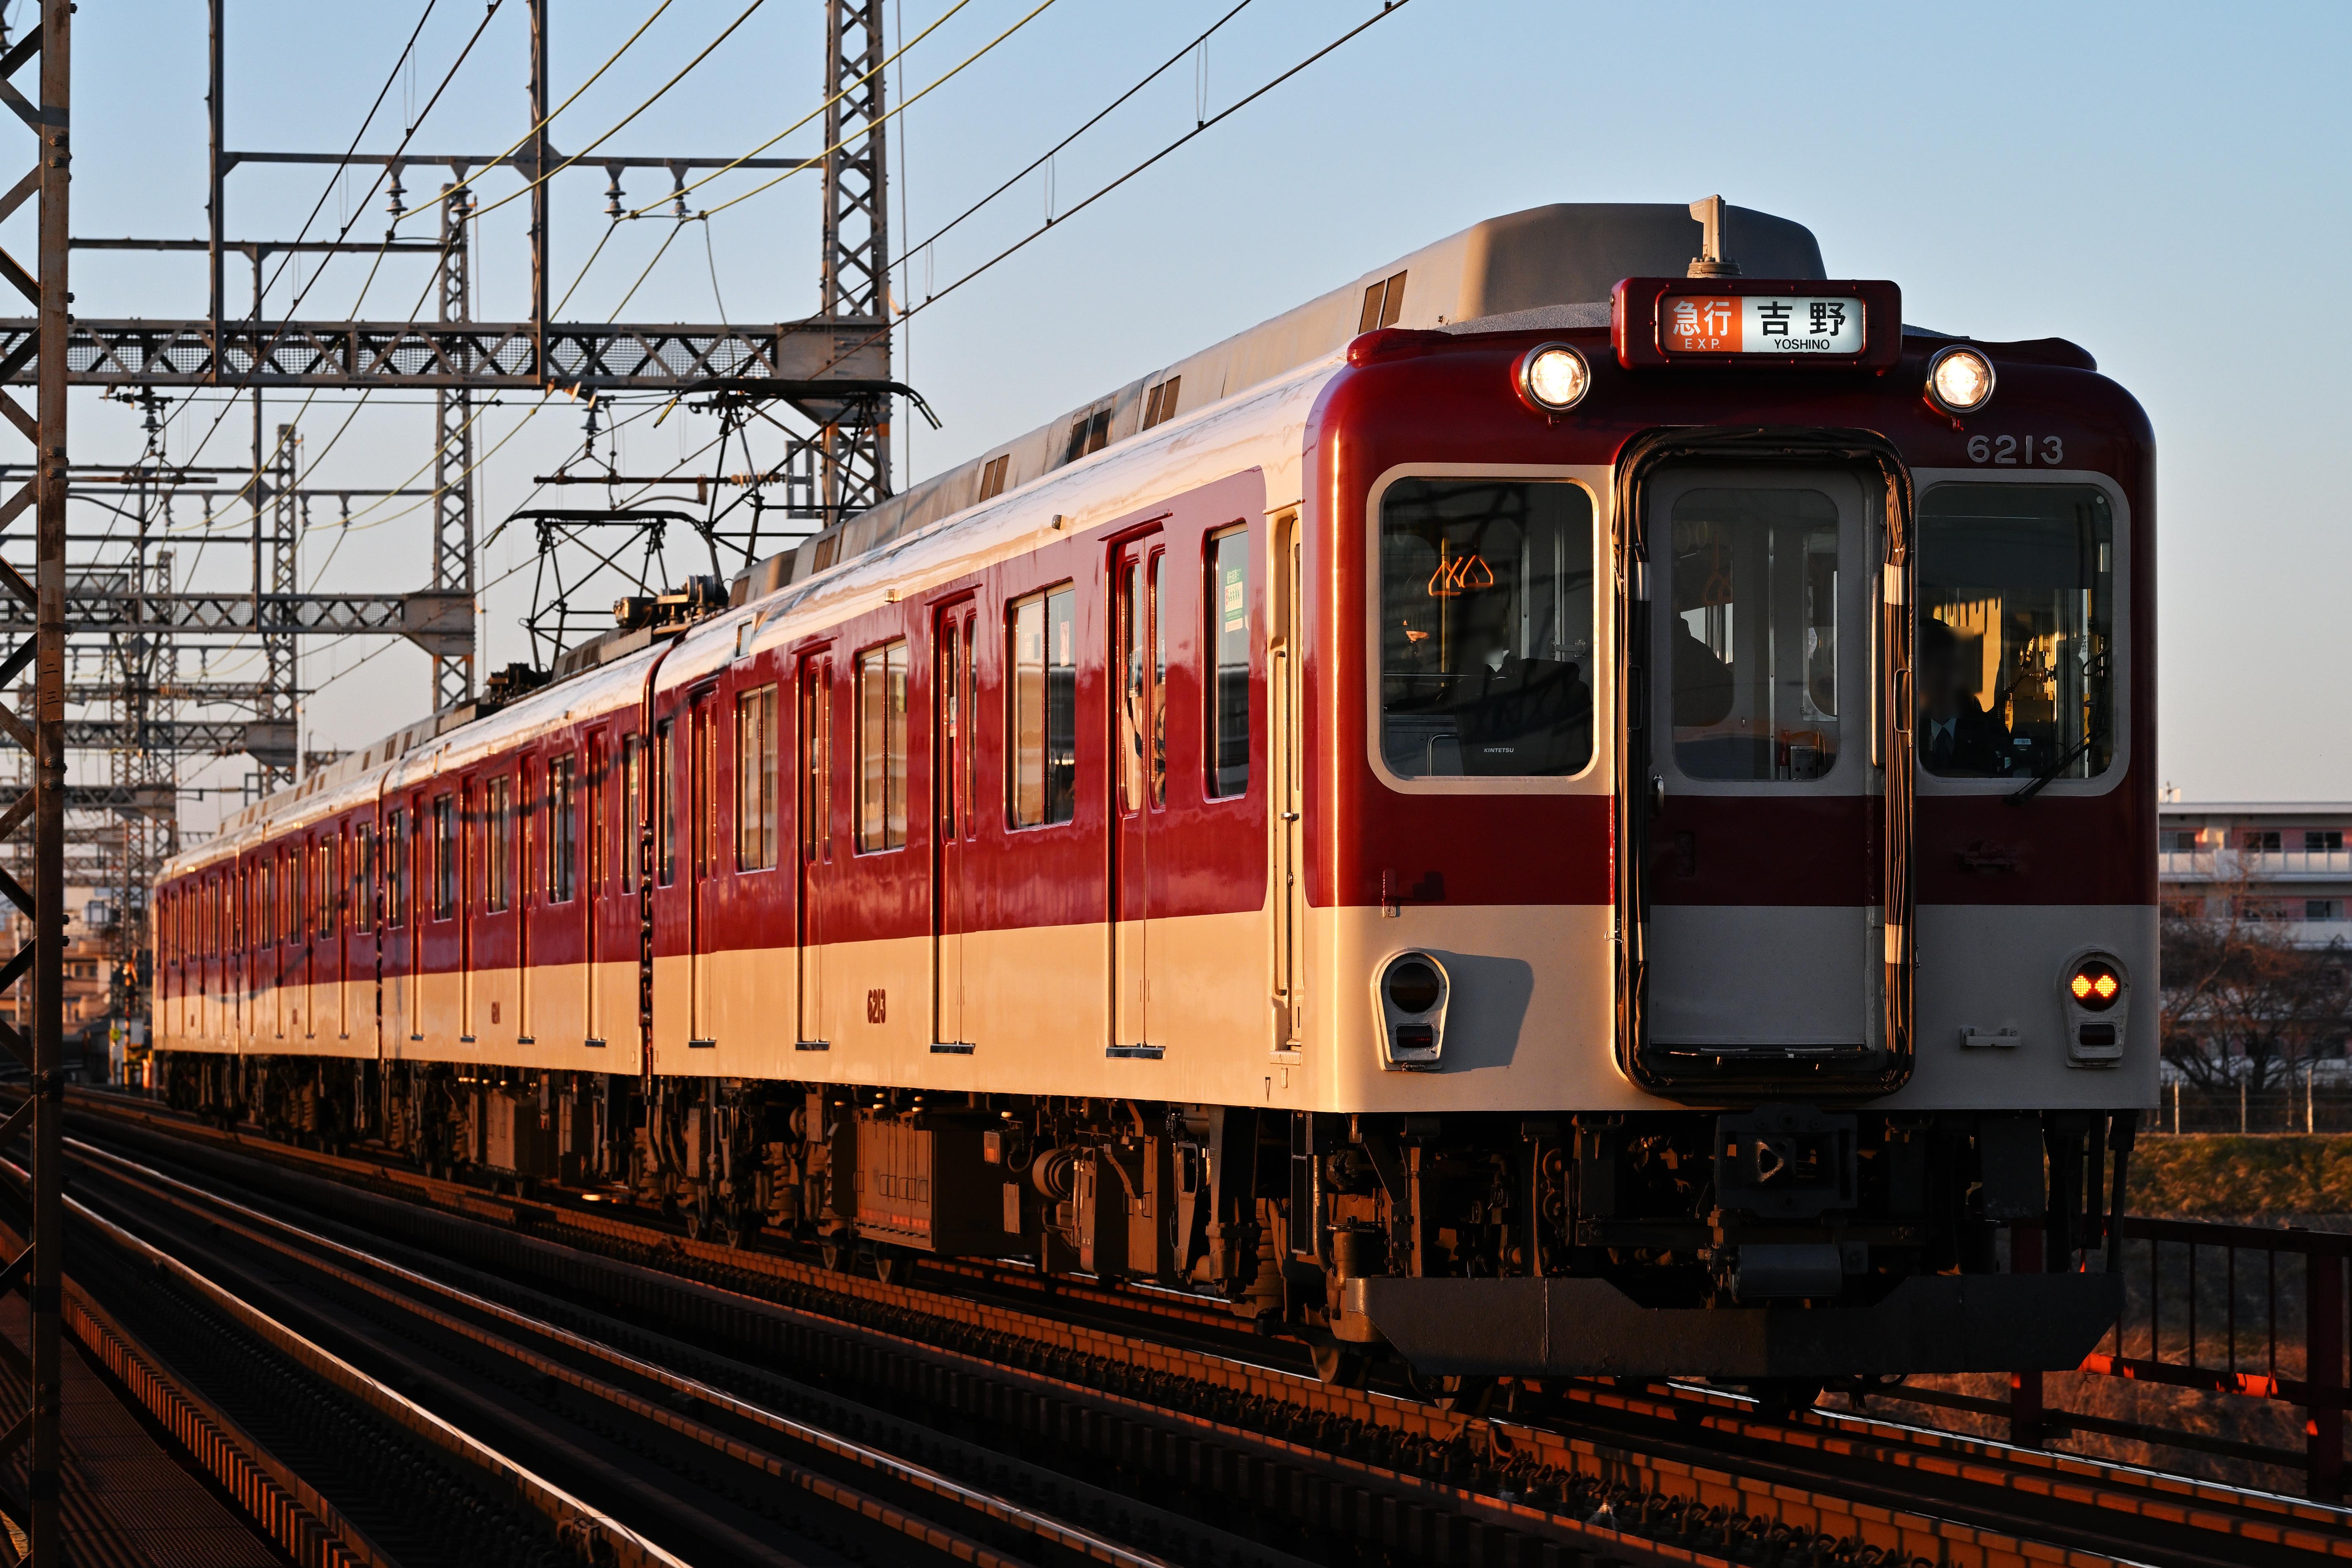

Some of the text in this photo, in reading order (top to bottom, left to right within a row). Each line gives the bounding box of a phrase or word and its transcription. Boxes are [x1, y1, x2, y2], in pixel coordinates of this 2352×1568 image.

[1673, 300, 1731, 336] 急行
[1757, 301, 1846, 336] 吉野
[1685, 338, 1720, 349] EXP.
[1774, 339, 1830, 350] YOSHINO
[1967, 435, 2064, 465] 6213
[867, 989, 886, 1024] 6213
